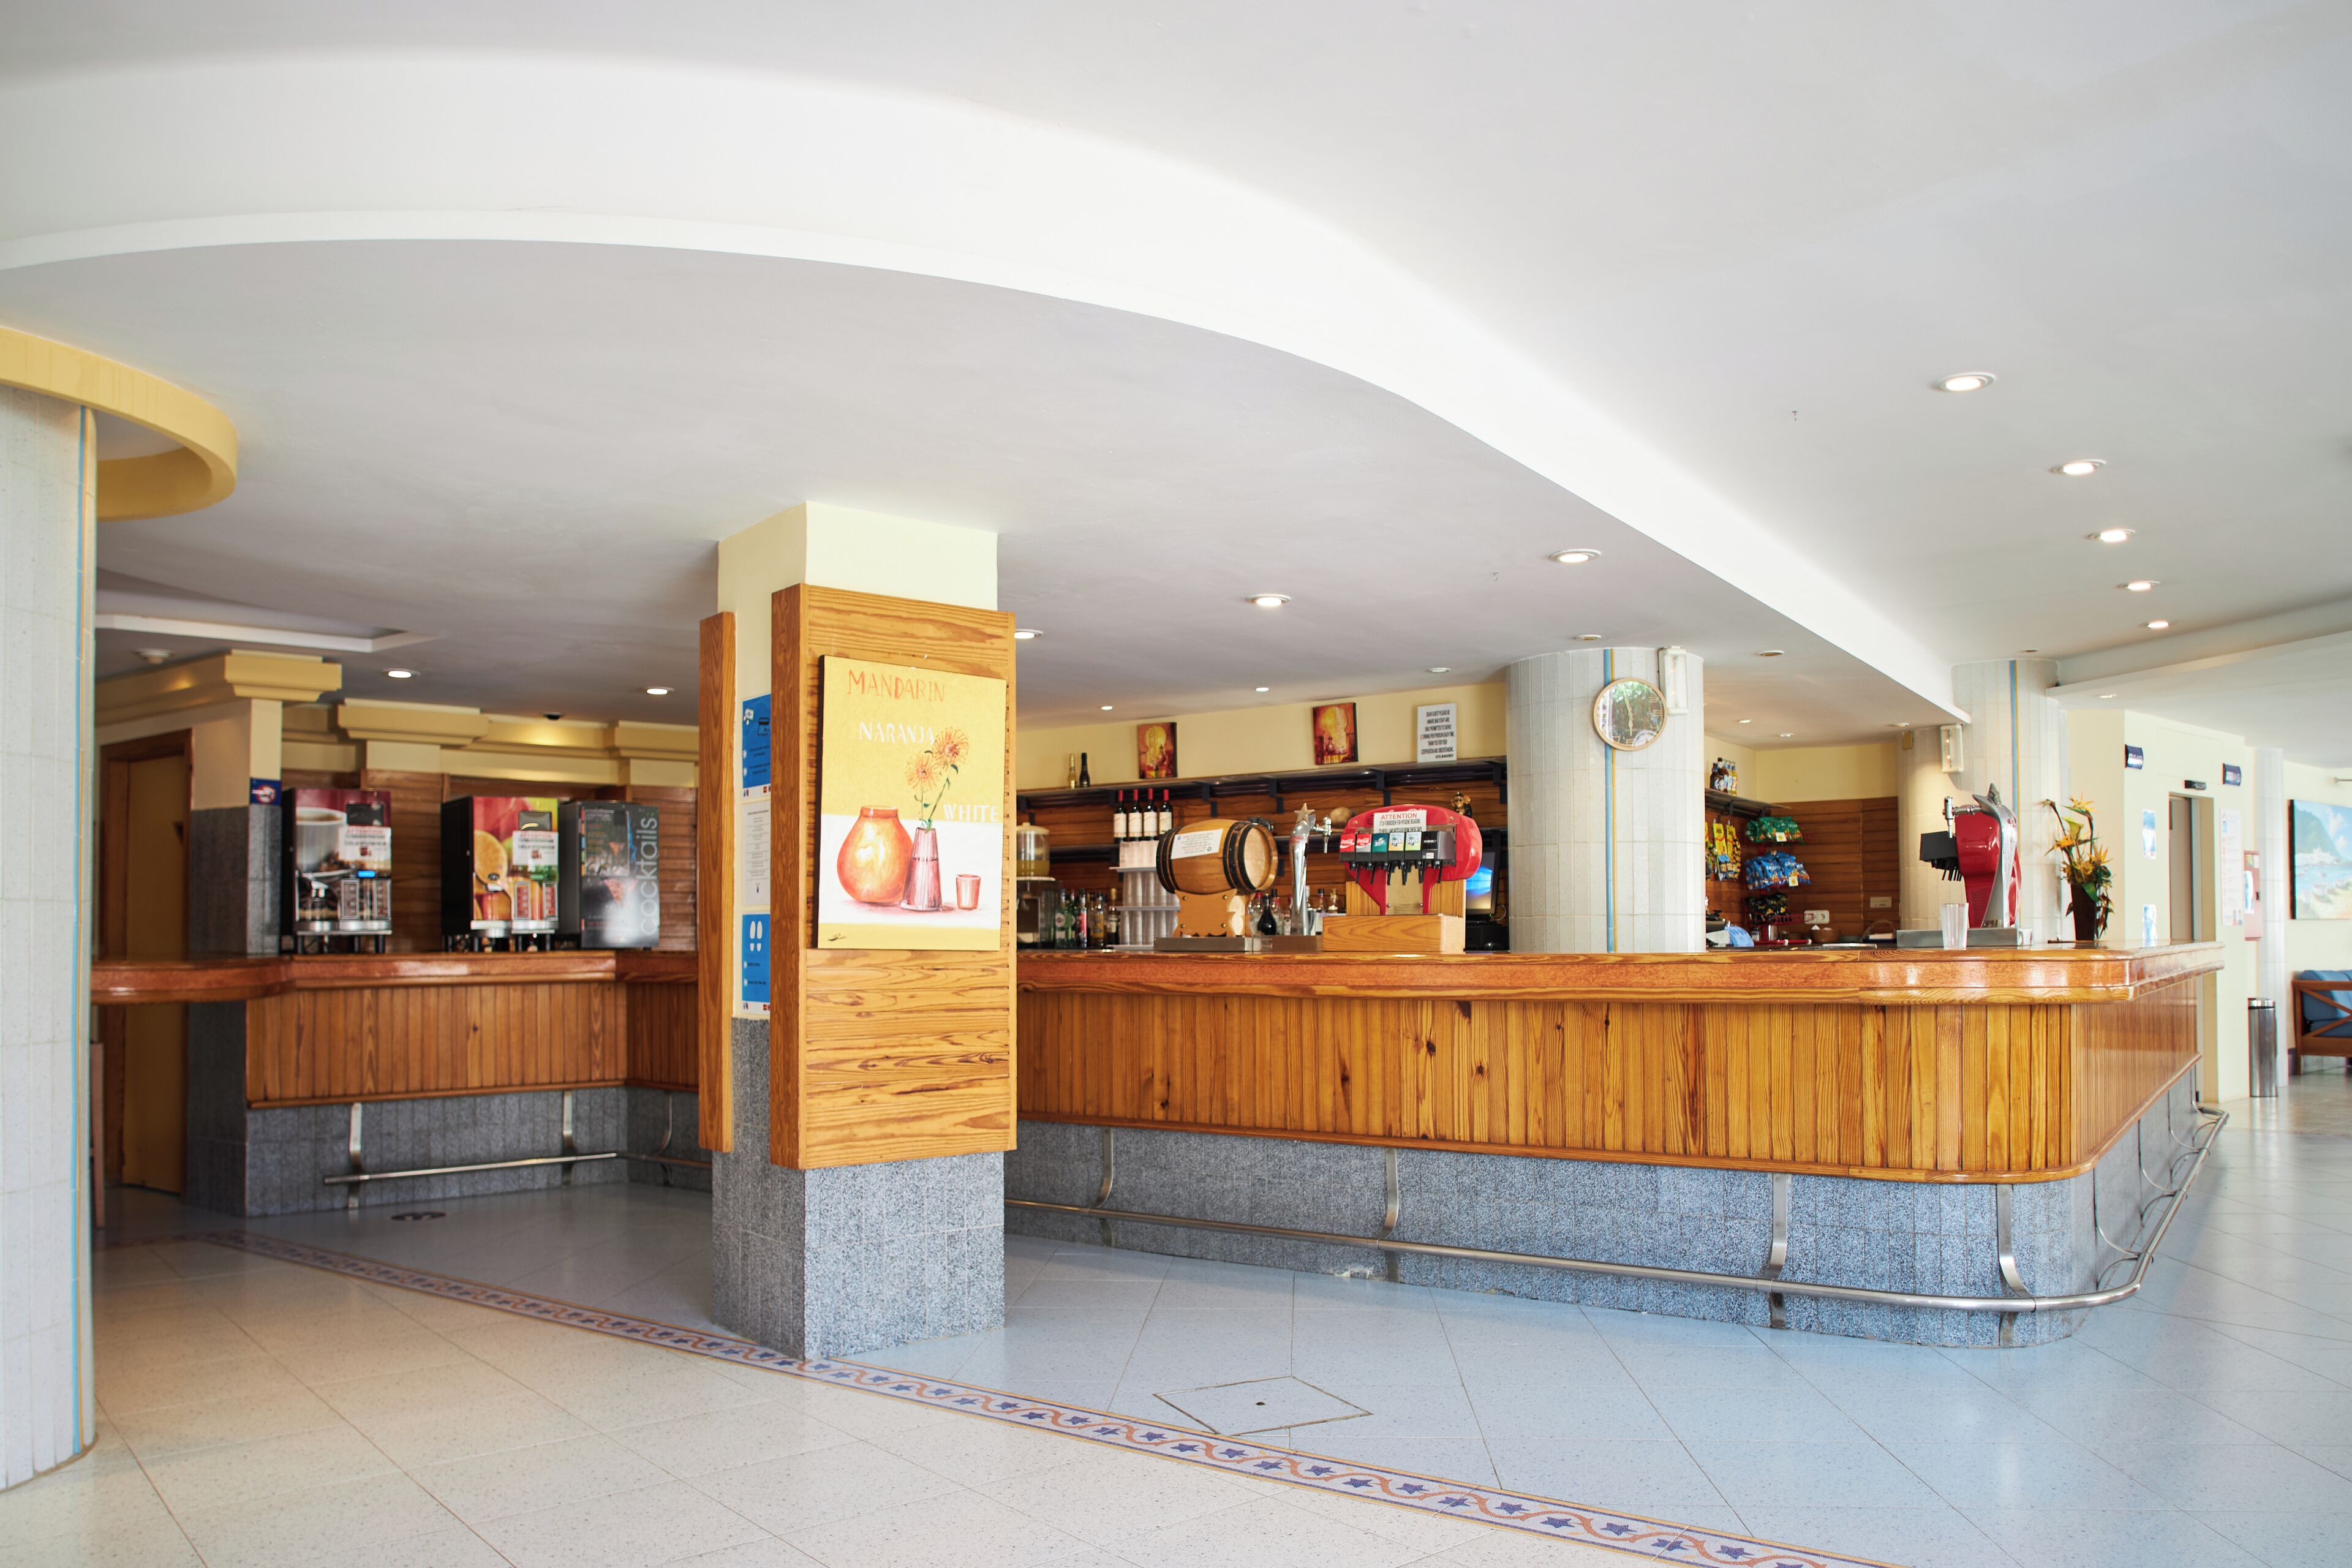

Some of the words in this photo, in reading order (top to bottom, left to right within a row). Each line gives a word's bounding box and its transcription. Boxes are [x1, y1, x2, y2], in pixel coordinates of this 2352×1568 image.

[847, 669, 945, 702] MANDARIN
[859, 721, 935, 745] NARANJA
[943, 804, 998, 823] WHITE
[636, 817, 657, 935] cocktails
